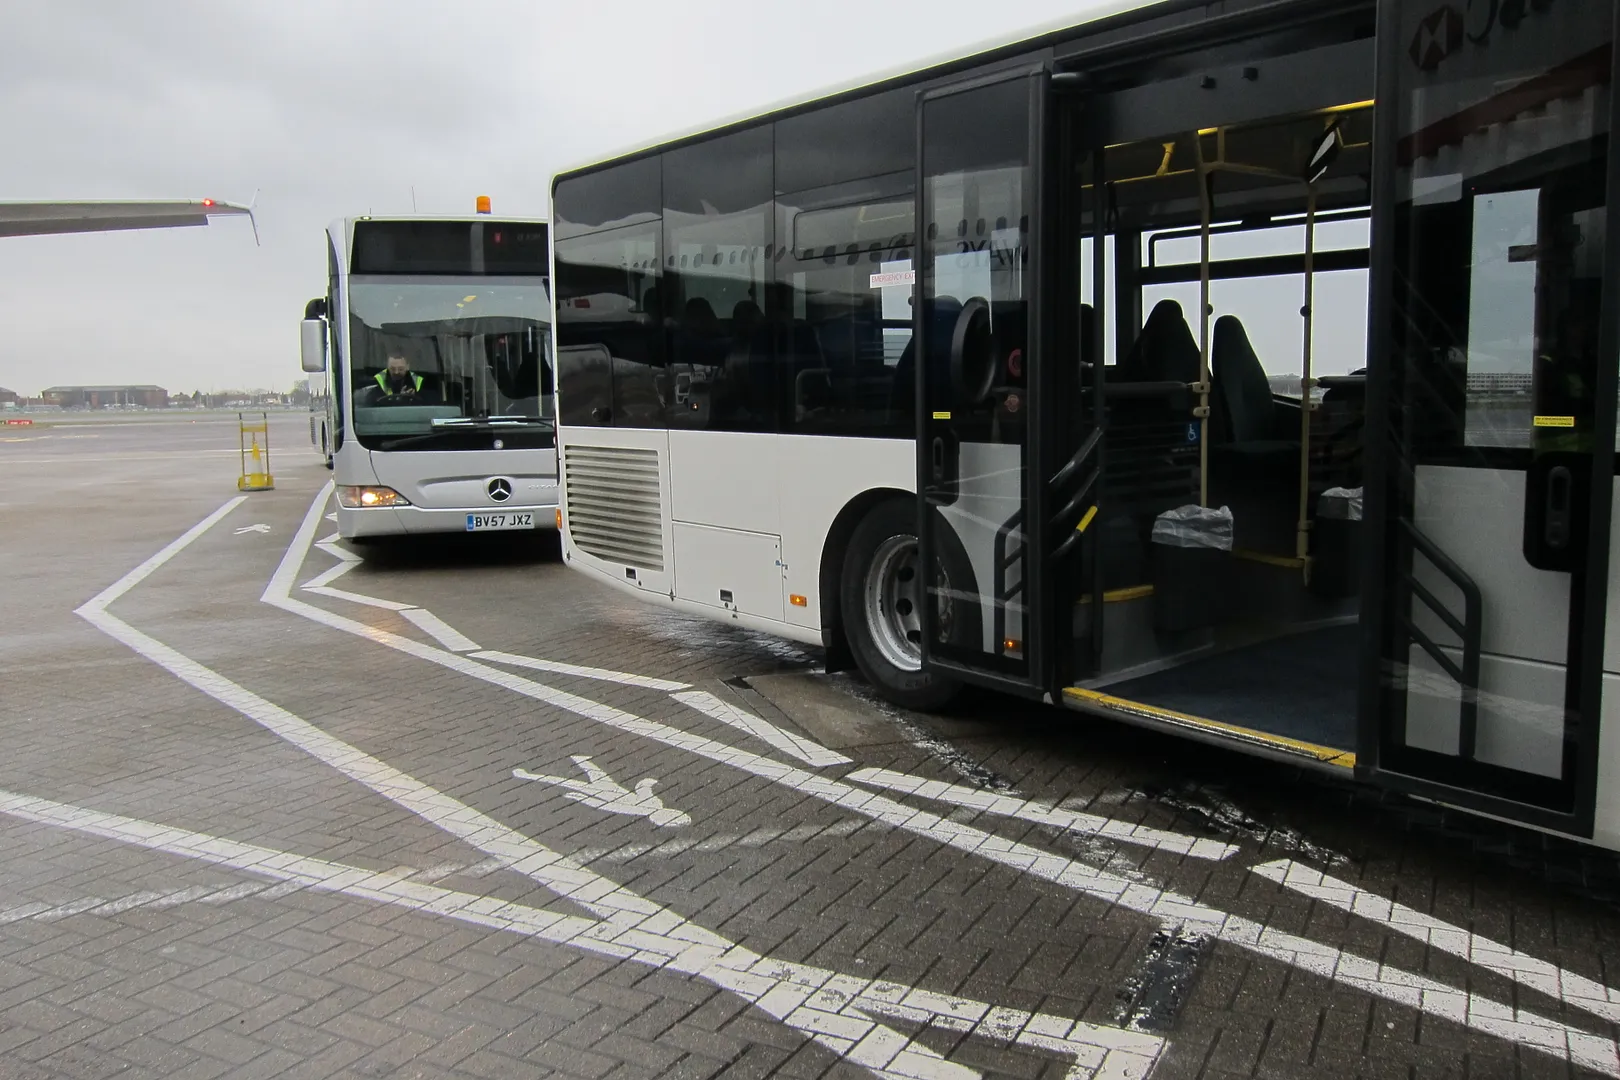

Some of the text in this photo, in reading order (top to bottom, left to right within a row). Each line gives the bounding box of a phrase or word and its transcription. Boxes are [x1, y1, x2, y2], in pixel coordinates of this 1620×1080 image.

[872, 272, 915, 284] EMERGENCY EXI
[475, 515, 505, 527] BV57
[509, 514, 531, 526] JXZ
